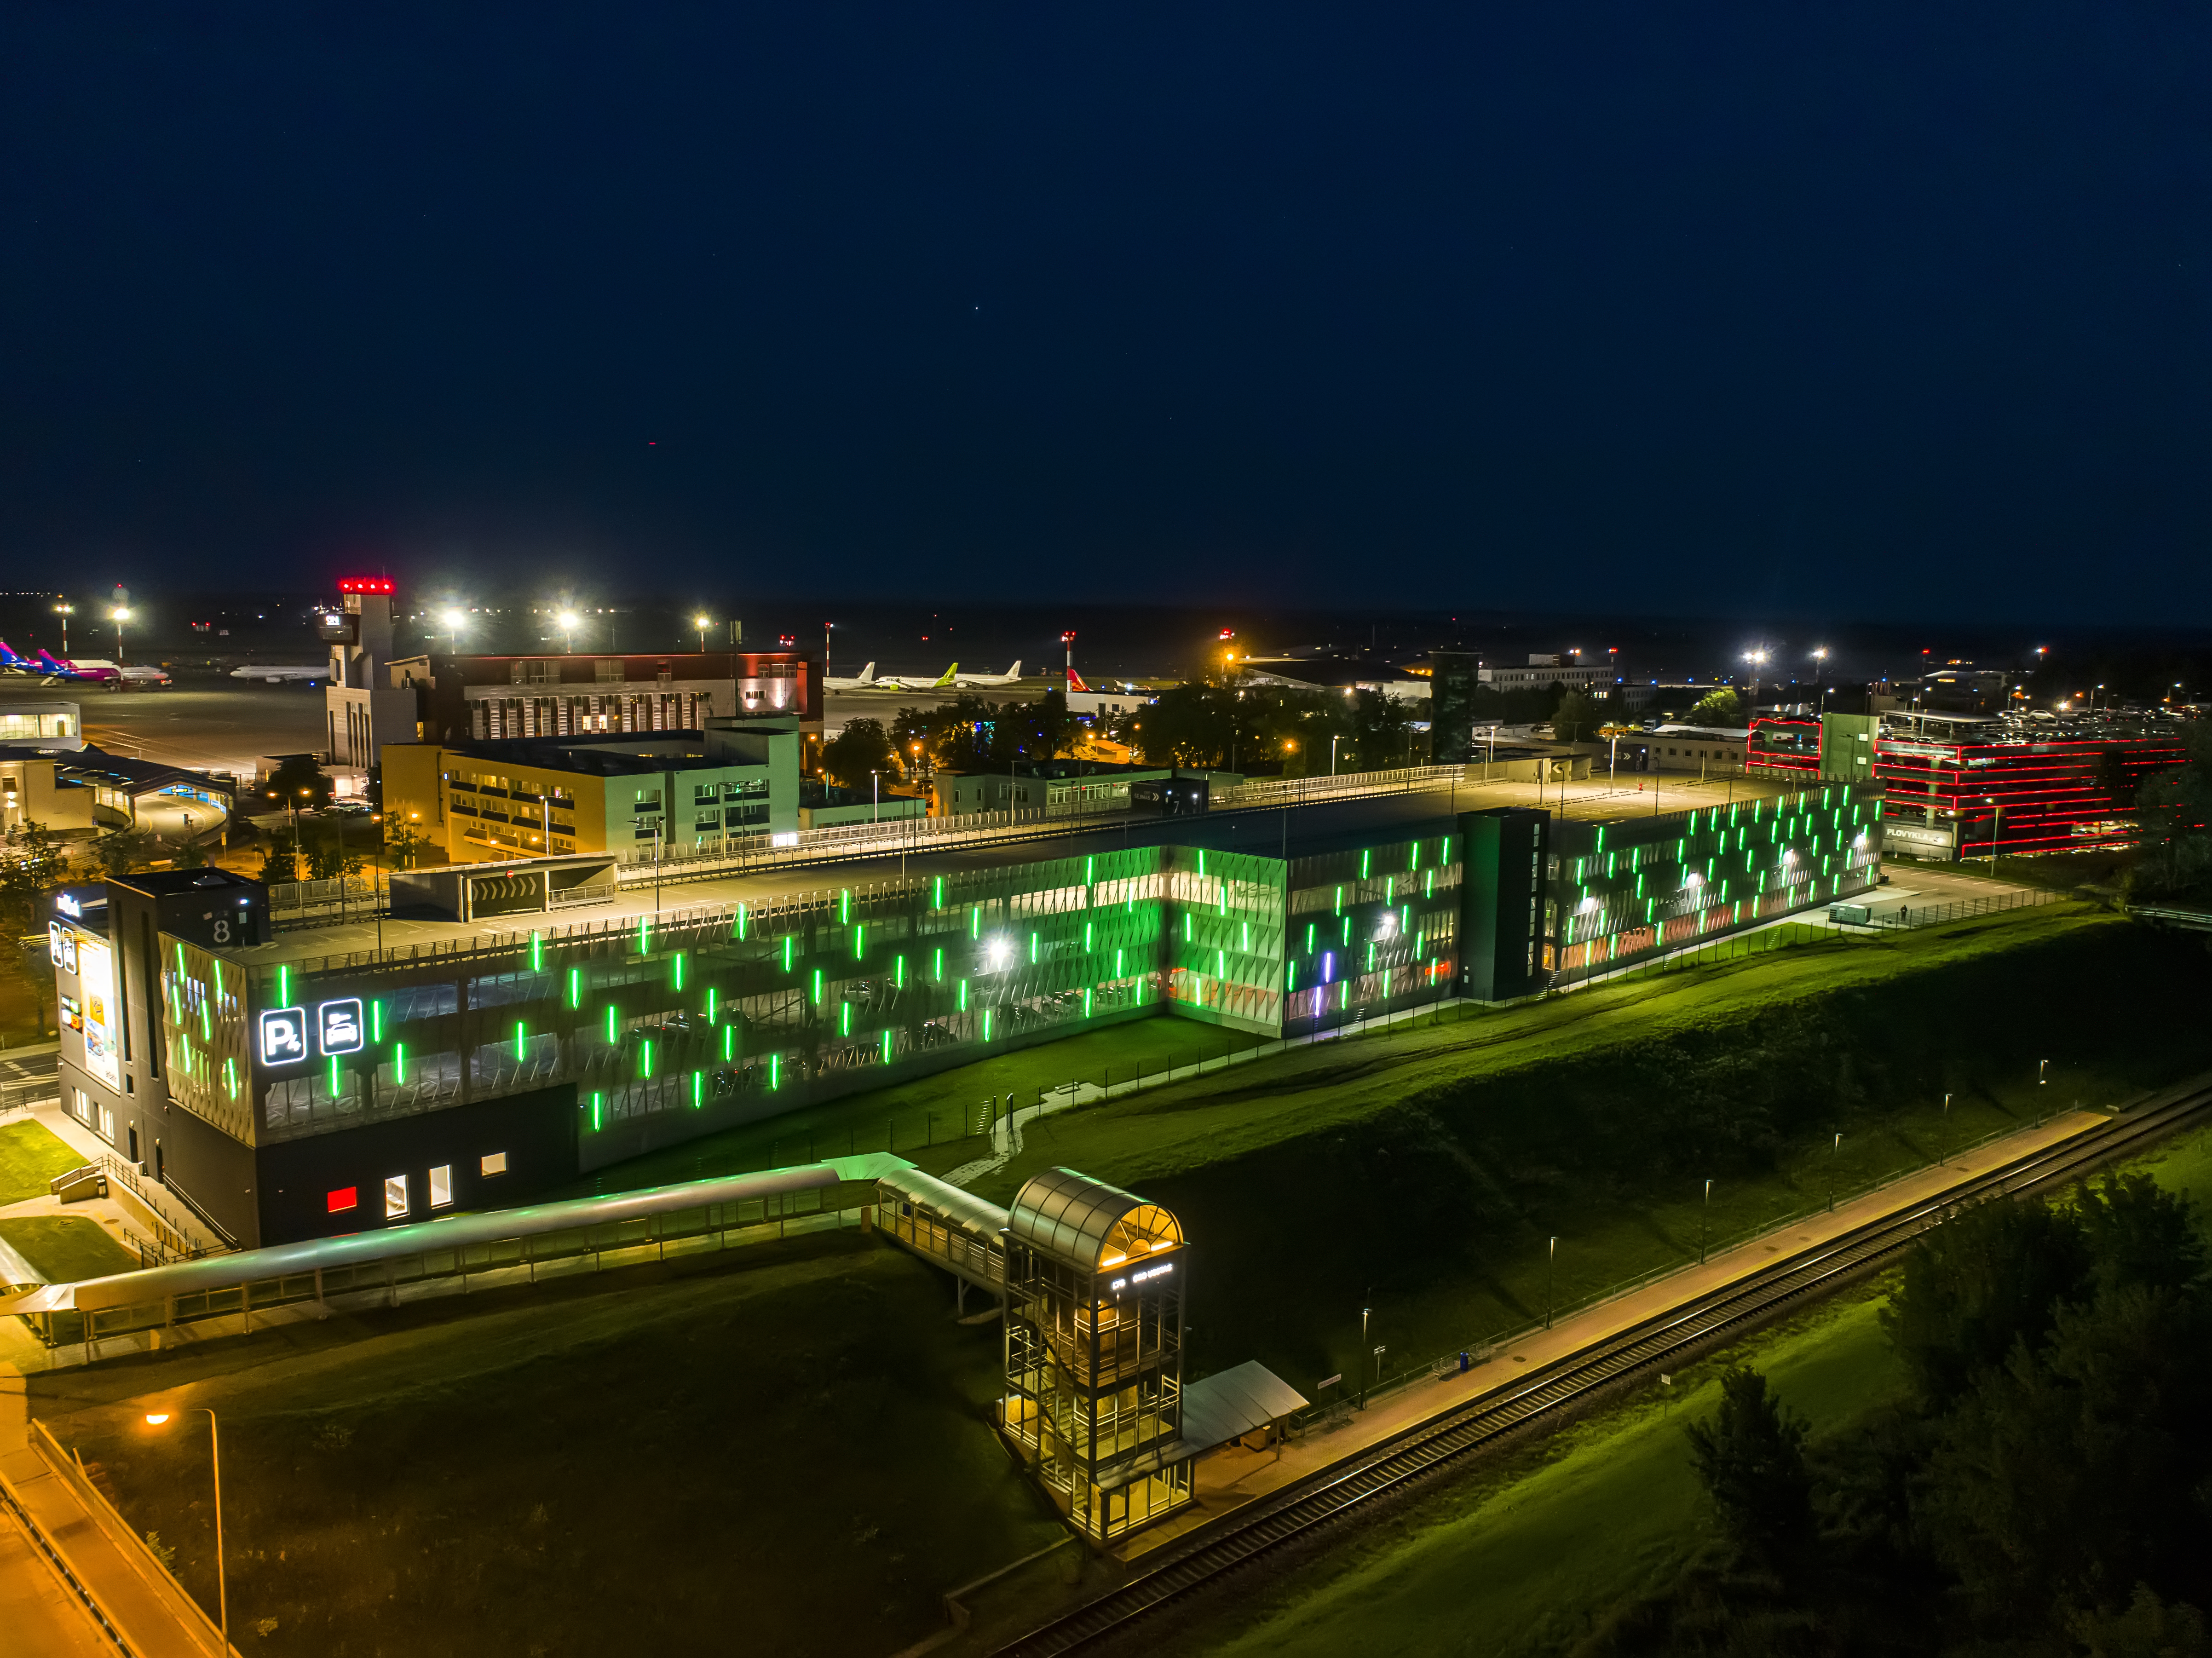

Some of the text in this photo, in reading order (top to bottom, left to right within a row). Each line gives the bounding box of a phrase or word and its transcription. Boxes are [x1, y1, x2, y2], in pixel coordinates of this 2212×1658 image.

[1174, 801, 1179, 813] 7
[1887, 828, 1929, 841] PLOVYKLA
[213, 920, 230, 943] 8
[265, 1019, 301, 1056] P4
